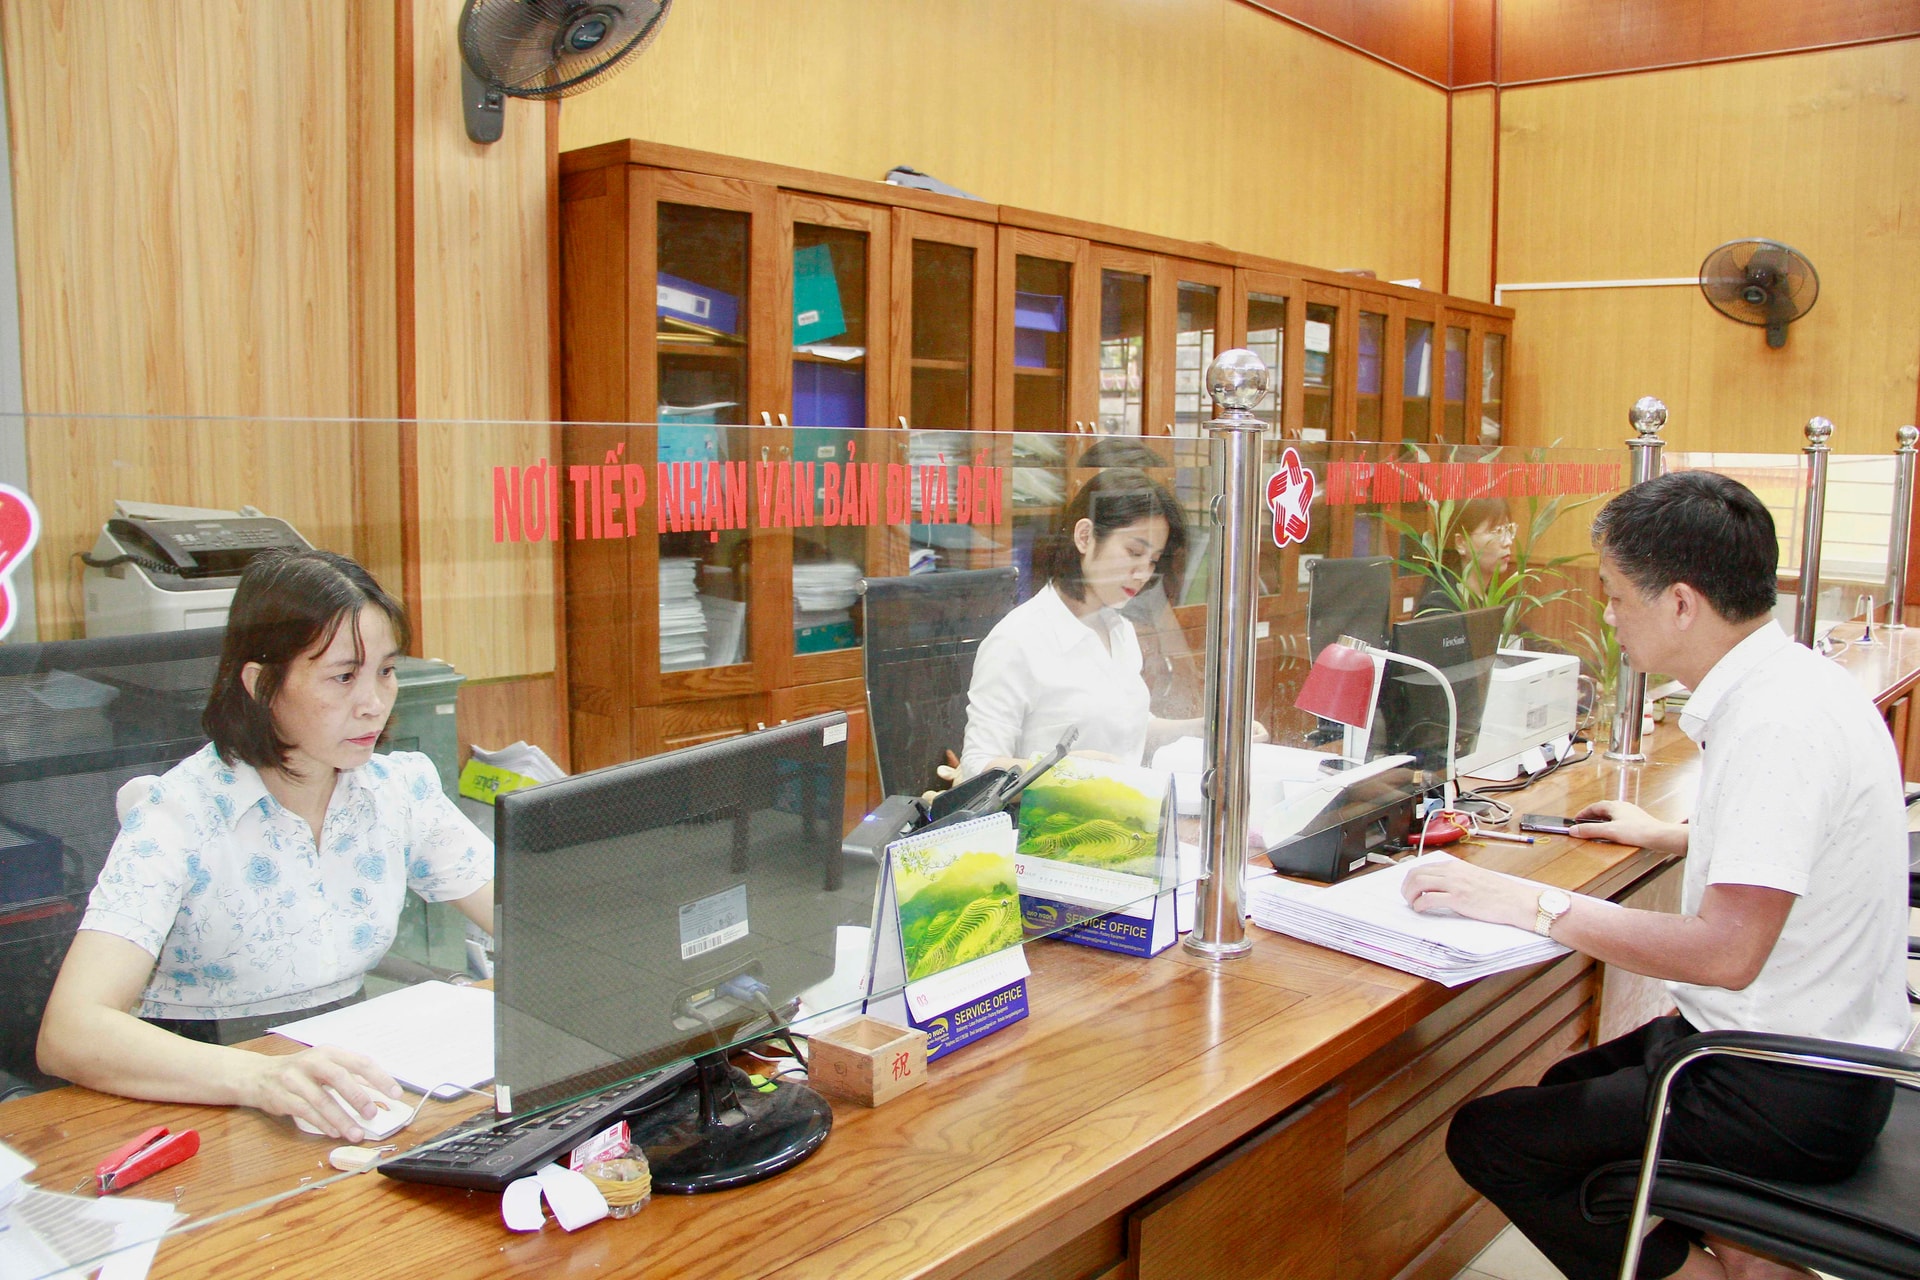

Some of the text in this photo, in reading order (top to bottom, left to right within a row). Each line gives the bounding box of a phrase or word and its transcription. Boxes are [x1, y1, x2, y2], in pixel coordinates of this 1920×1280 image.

[493, 458, 558, 543] NƠI
[570, 442, 646, 541] TIẾP
[823, 440, 879, 526] BẢN
[886, 463, 912, 525] ĐI
[919, 452, 950, 525] VÀ
[956, 447, 1003, 525] ĐẾN
[1109, 921, 1147, 939] OFFICE
[954, 999, 992, 1026] SERVICE
[992, 985, 1023, 1009] OFFICE
[892, 1052, 911, 1081] 祝
